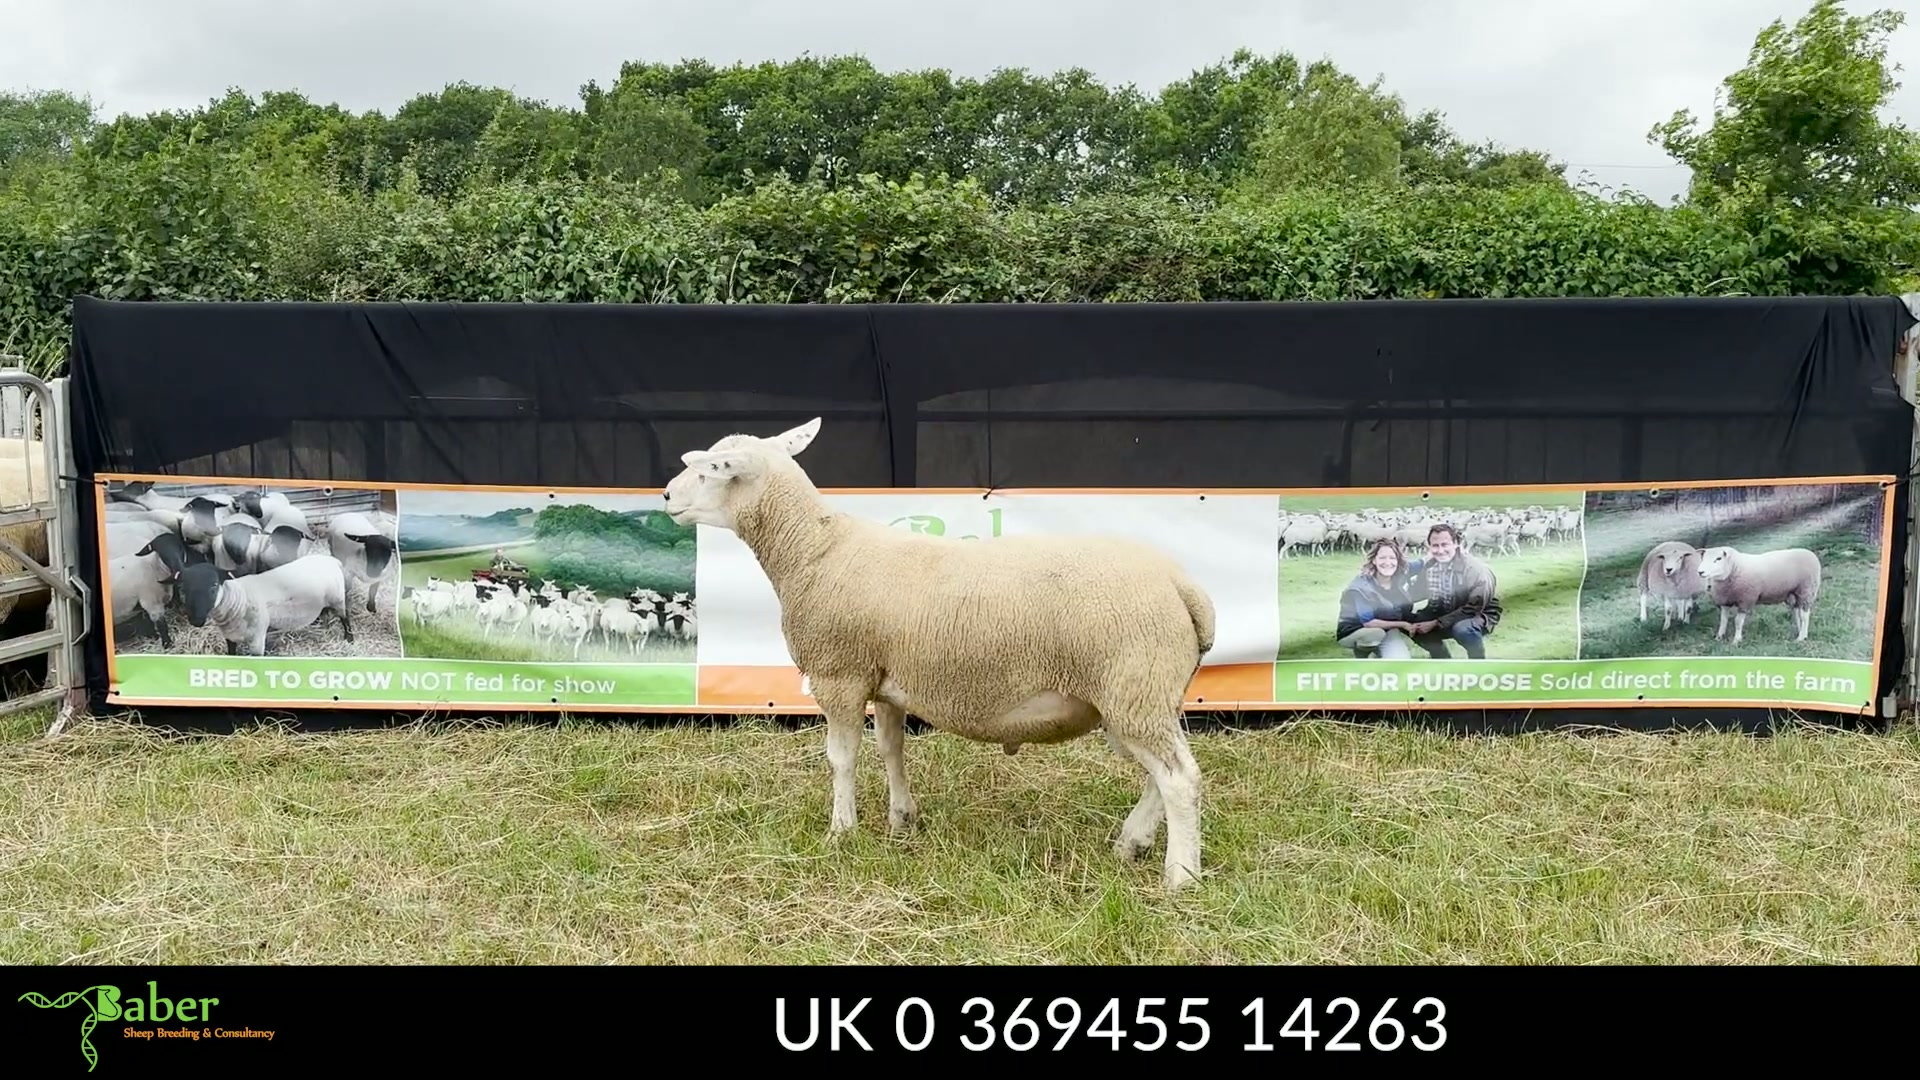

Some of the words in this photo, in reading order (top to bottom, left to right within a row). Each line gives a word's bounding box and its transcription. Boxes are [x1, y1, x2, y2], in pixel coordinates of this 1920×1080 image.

[189, 668, 258, 688] BRED
[265, 670, 301, 689] TO
[308, 671, 394, 690] GROW
[401, 672, 456, 691] NOT
[464, 672, 504, 692] fed
[511, 673, 545, 692] for
[553, 676, 616, 694] show
[1296, 672, 1337, 691] FIT
[1344, 672, 1399, 691] FOR
[1406, 673, 1532, 691] PURPOSE
[1540, 672, 1592, 690] Sold
[1601, 671, 1672, 689] direct
[1680, 670, 1736, 688] from
[1746, 670, 1785, 689] the
[1794, 671, 1856, 693] farm
